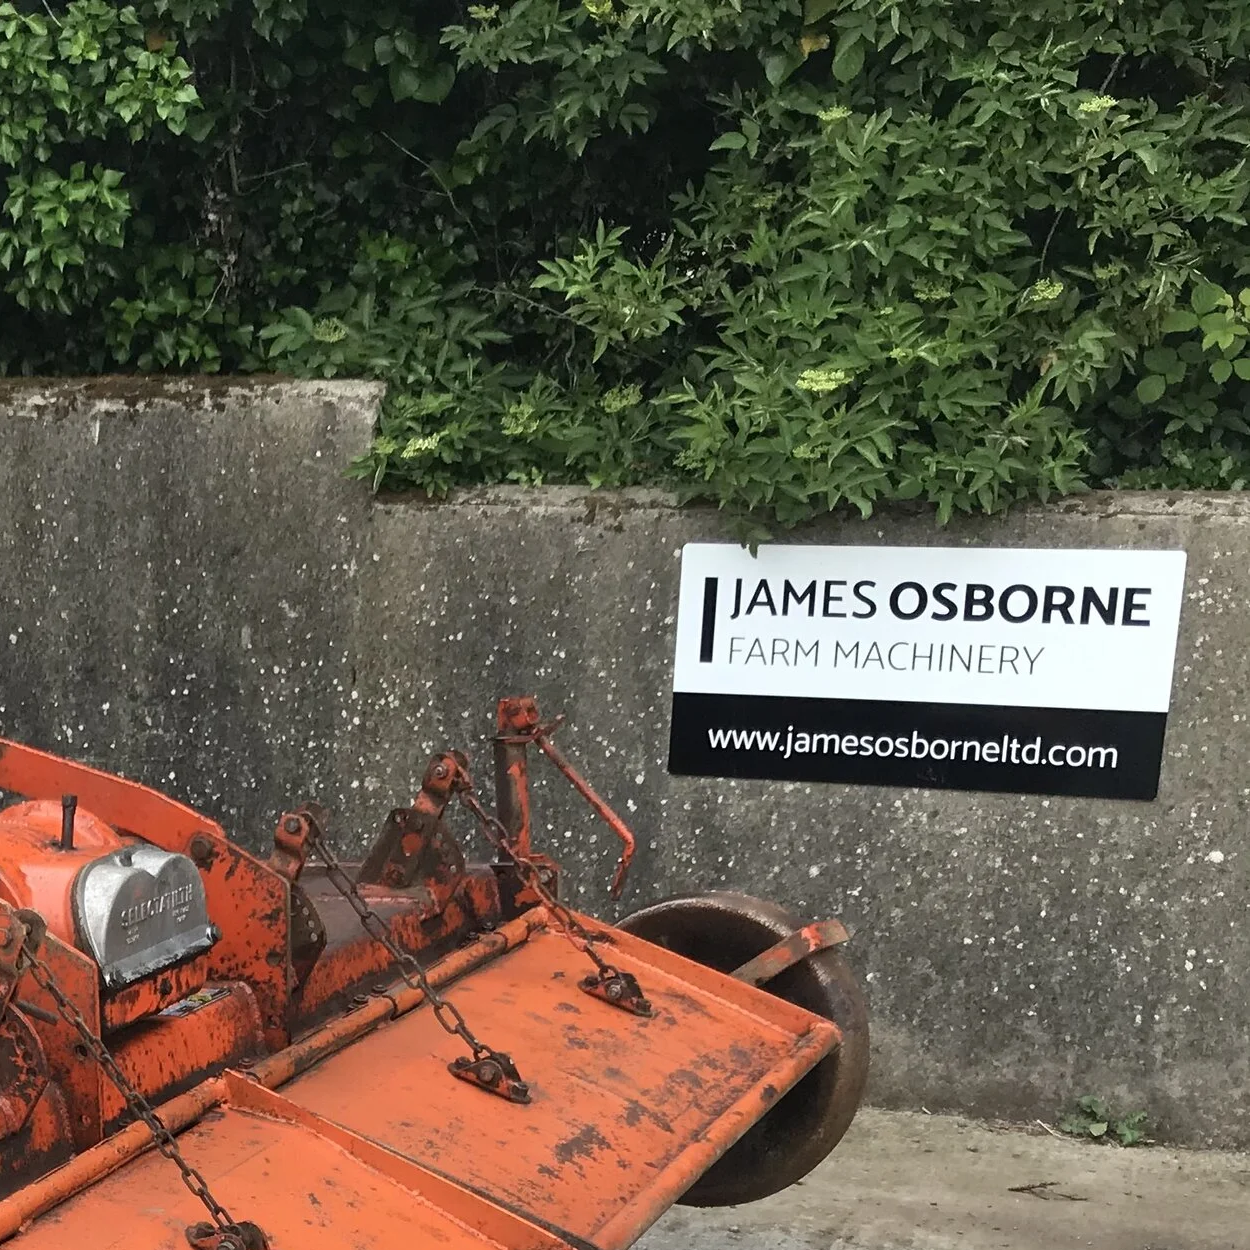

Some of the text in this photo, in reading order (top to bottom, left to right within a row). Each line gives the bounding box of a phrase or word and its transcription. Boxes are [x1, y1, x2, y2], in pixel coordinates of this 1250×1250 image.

[731, 579, 1151, 626] JAMES OSBORNE
[729, 637, 1044, 675] FARM MACHINERY
[708, 726, 1117, 768] www.jamesosborneltd.com
